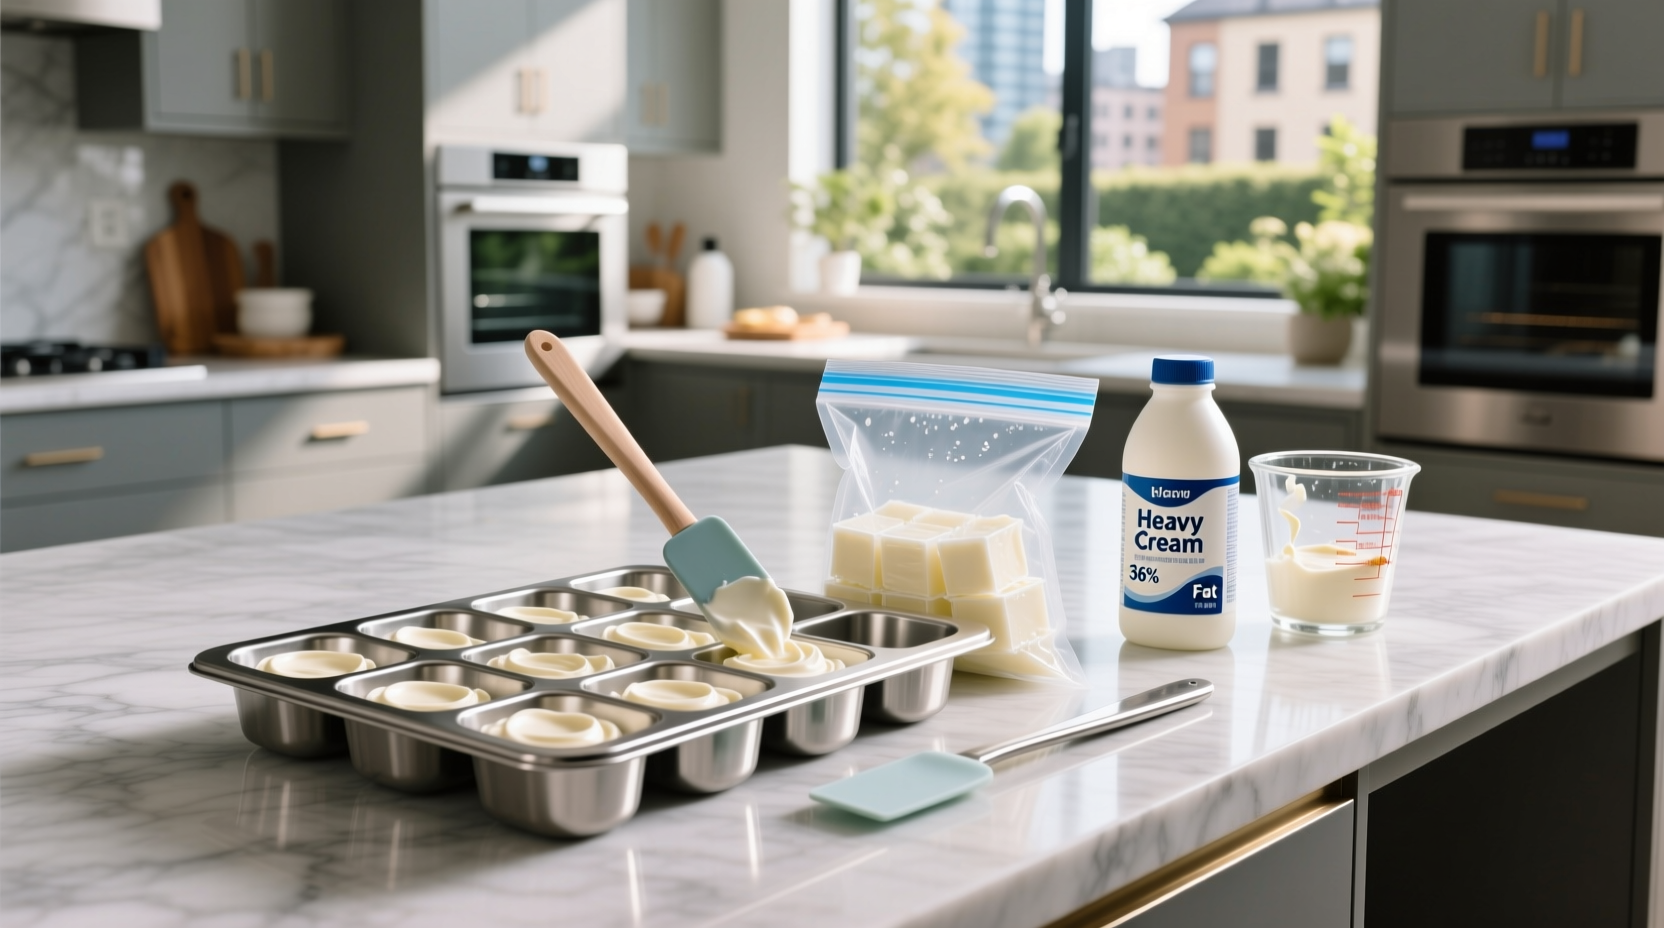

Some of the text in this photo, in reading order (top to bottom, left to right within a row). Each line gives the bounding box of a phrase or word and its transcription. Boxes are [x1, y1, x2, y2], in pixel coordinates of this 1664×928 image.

[1137, 508, 1204, 537] Heavy
[1134, 530, 1203, 553] Cream
[1129, 564, 1159, 584] 36%
[1192, 583, 1218, 599] Fat
